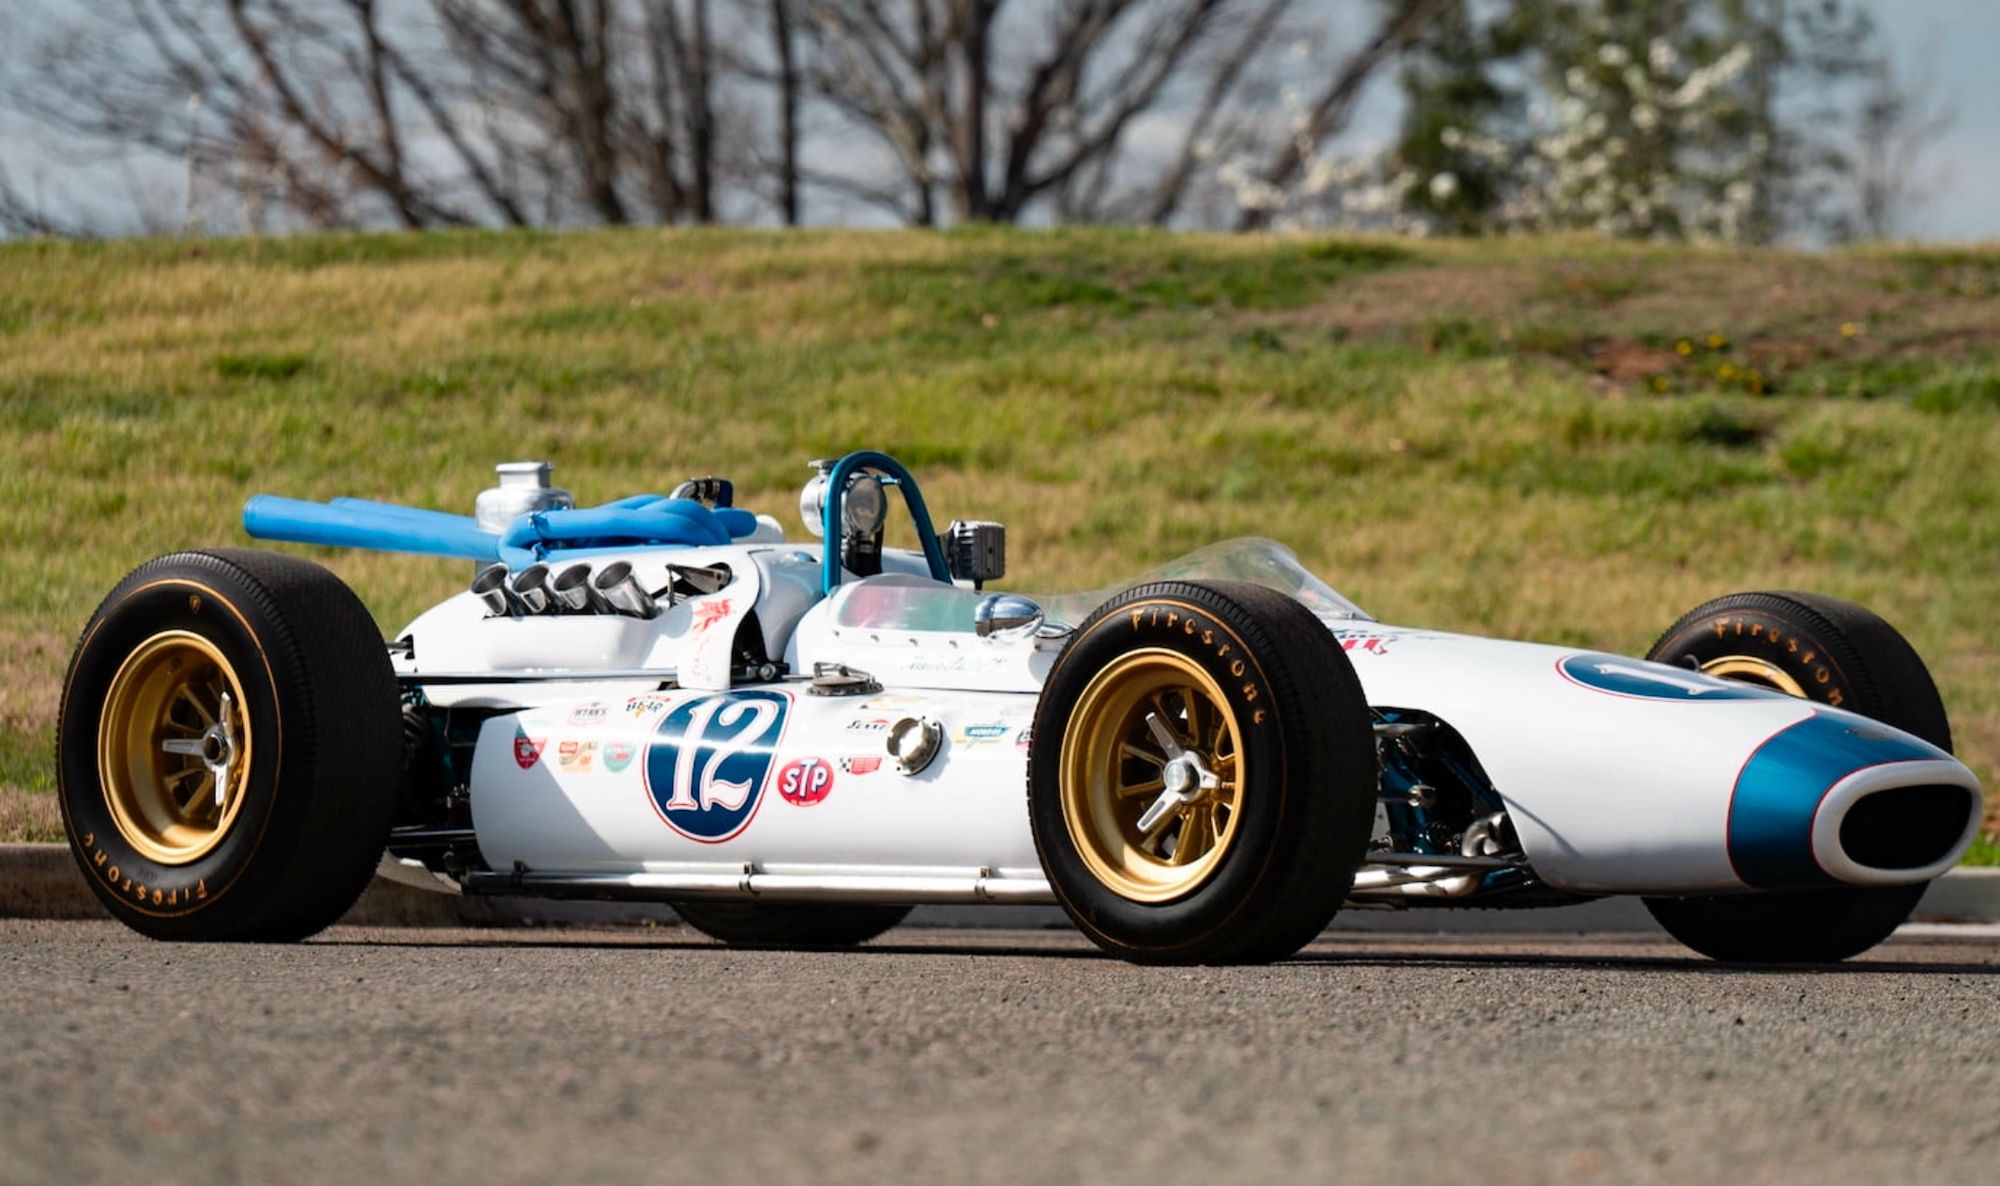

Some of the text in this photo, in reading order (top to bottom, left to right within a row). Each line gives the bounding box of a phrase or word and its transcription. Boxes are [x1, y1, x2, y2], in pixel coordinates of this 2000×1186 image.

[1130, 607, 1266, 725] Firestone
[1714, 607, 1844, 706] Fireston
[666, 697, 778, 811] 12
[783, 757, 828, 798] STP
[84, 832, 208, 905] Firestone
